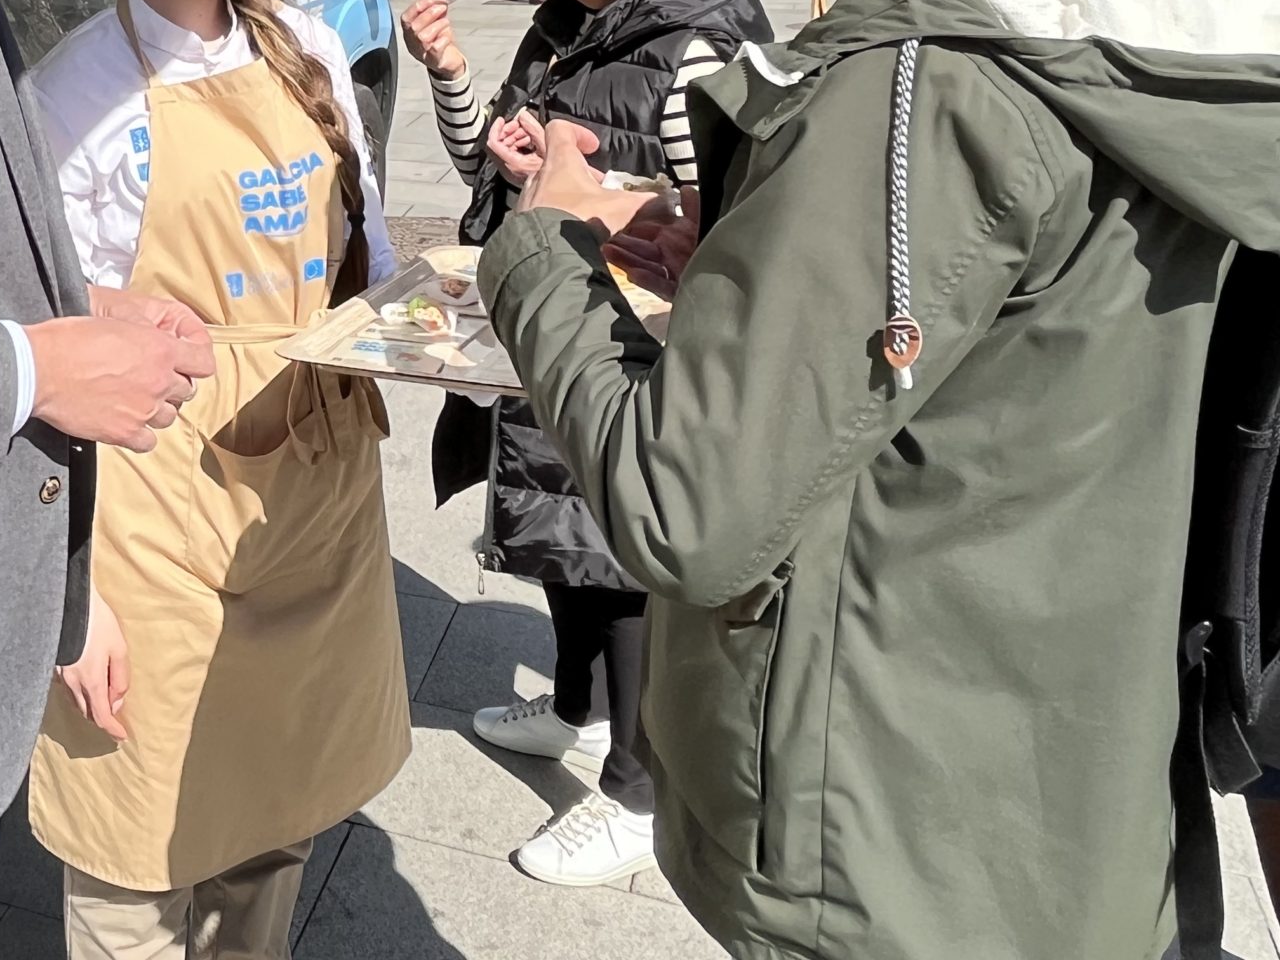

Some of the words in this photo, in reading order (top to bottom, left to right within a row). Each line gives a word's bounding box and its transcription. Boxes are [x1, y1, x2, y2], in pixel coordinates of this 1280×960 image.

[238, 152, 324, 190] GALCIA
[240, 183, 307, 212] SABE
[245, 211, 306, 234] AMA
